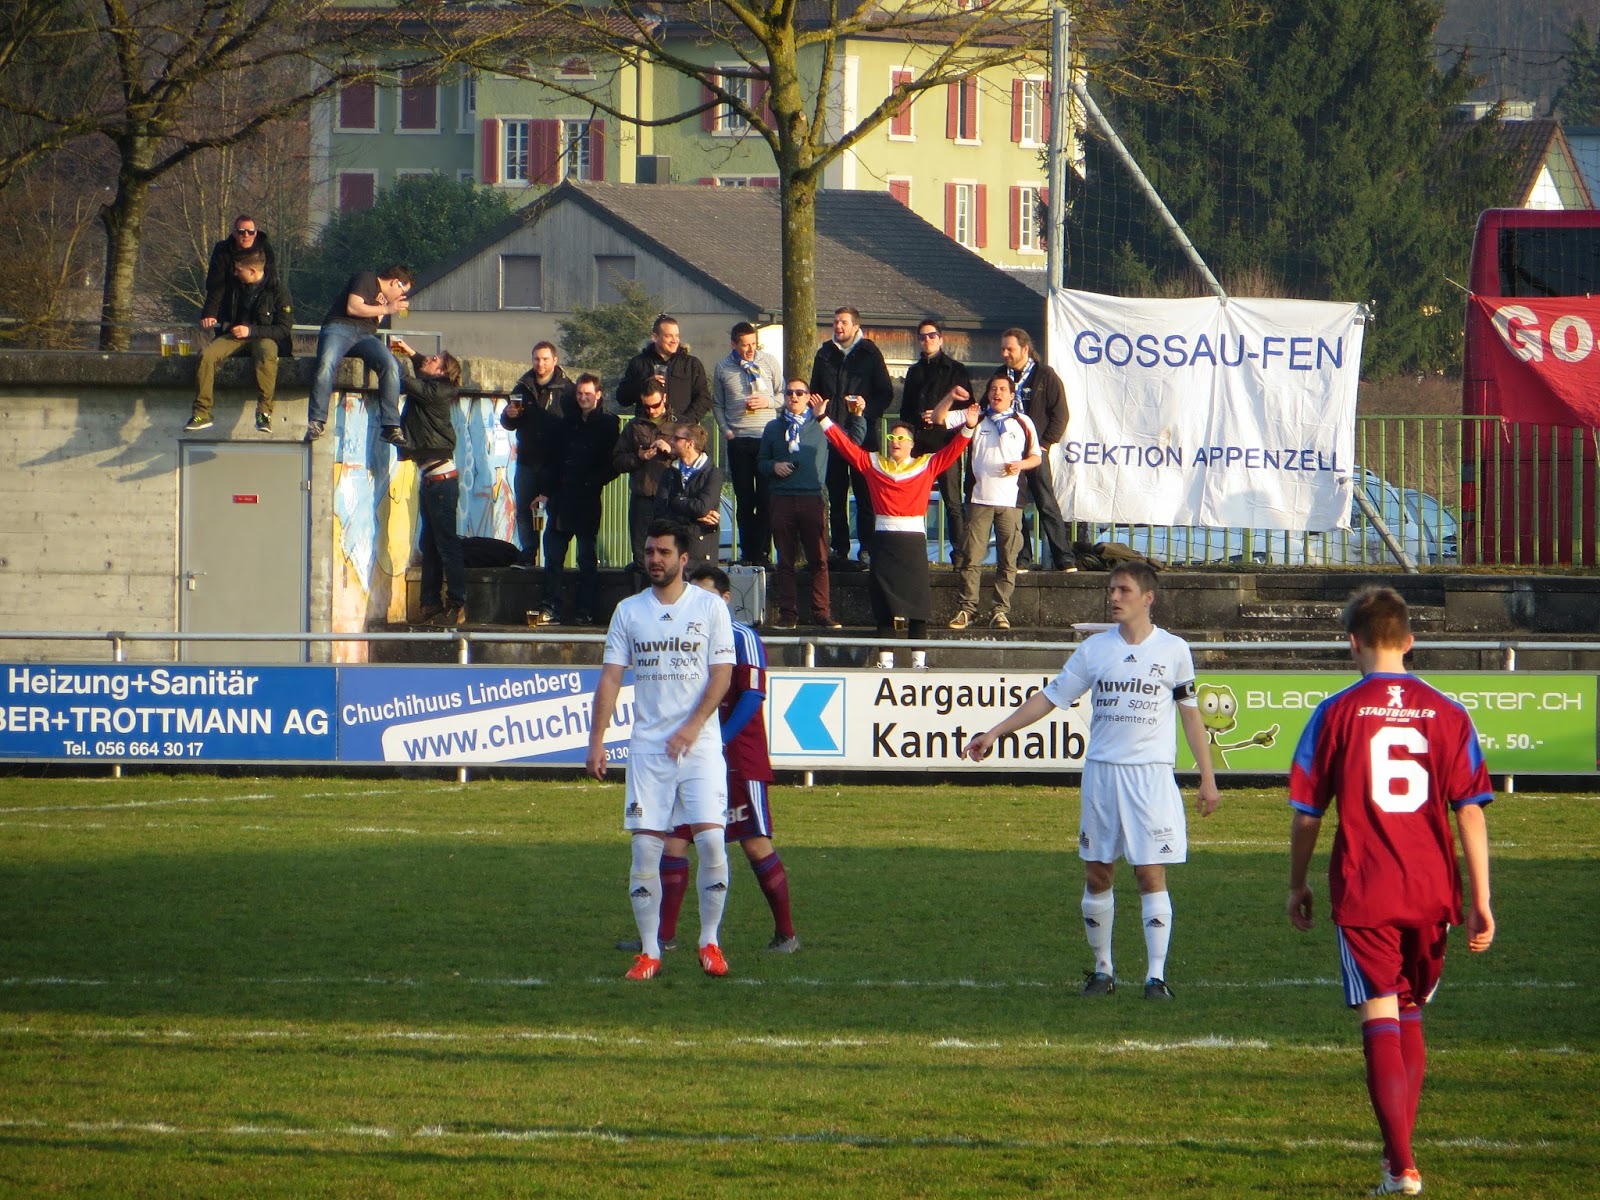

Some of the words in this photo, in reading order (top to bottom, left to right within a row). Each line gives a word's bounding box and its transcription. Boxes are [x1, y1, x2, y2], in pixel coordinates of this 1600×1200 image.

[1073, 330, 1343, 371] GOSSAU-FEN
[1064, 441, 1182, 467] SEKTION
[1192, 446, 1347, 473] APPENZELL
[632, 637, 701, 653] huwiler
[669, 657, 698, 669] sport
[8, 668, 259, 700] Heizung+Sanitär
[342, 691, 463, 726] Chuchihuus
[467, 671, 581, 705] Lindenberg
[1128, 699, 1159, 711] sport
[283, 709, 328, 735] AG
[63, 740, 91, 756] Tel.
[95, 741, 125, 756] 056
[129, 741, 159, 756] 664
[163, 741, 183, 756] 30
[186, 742, 203, 756] 17
[1506, 733, 1544, 750] 50.-
[1370, 726, 1429, 813] 6
